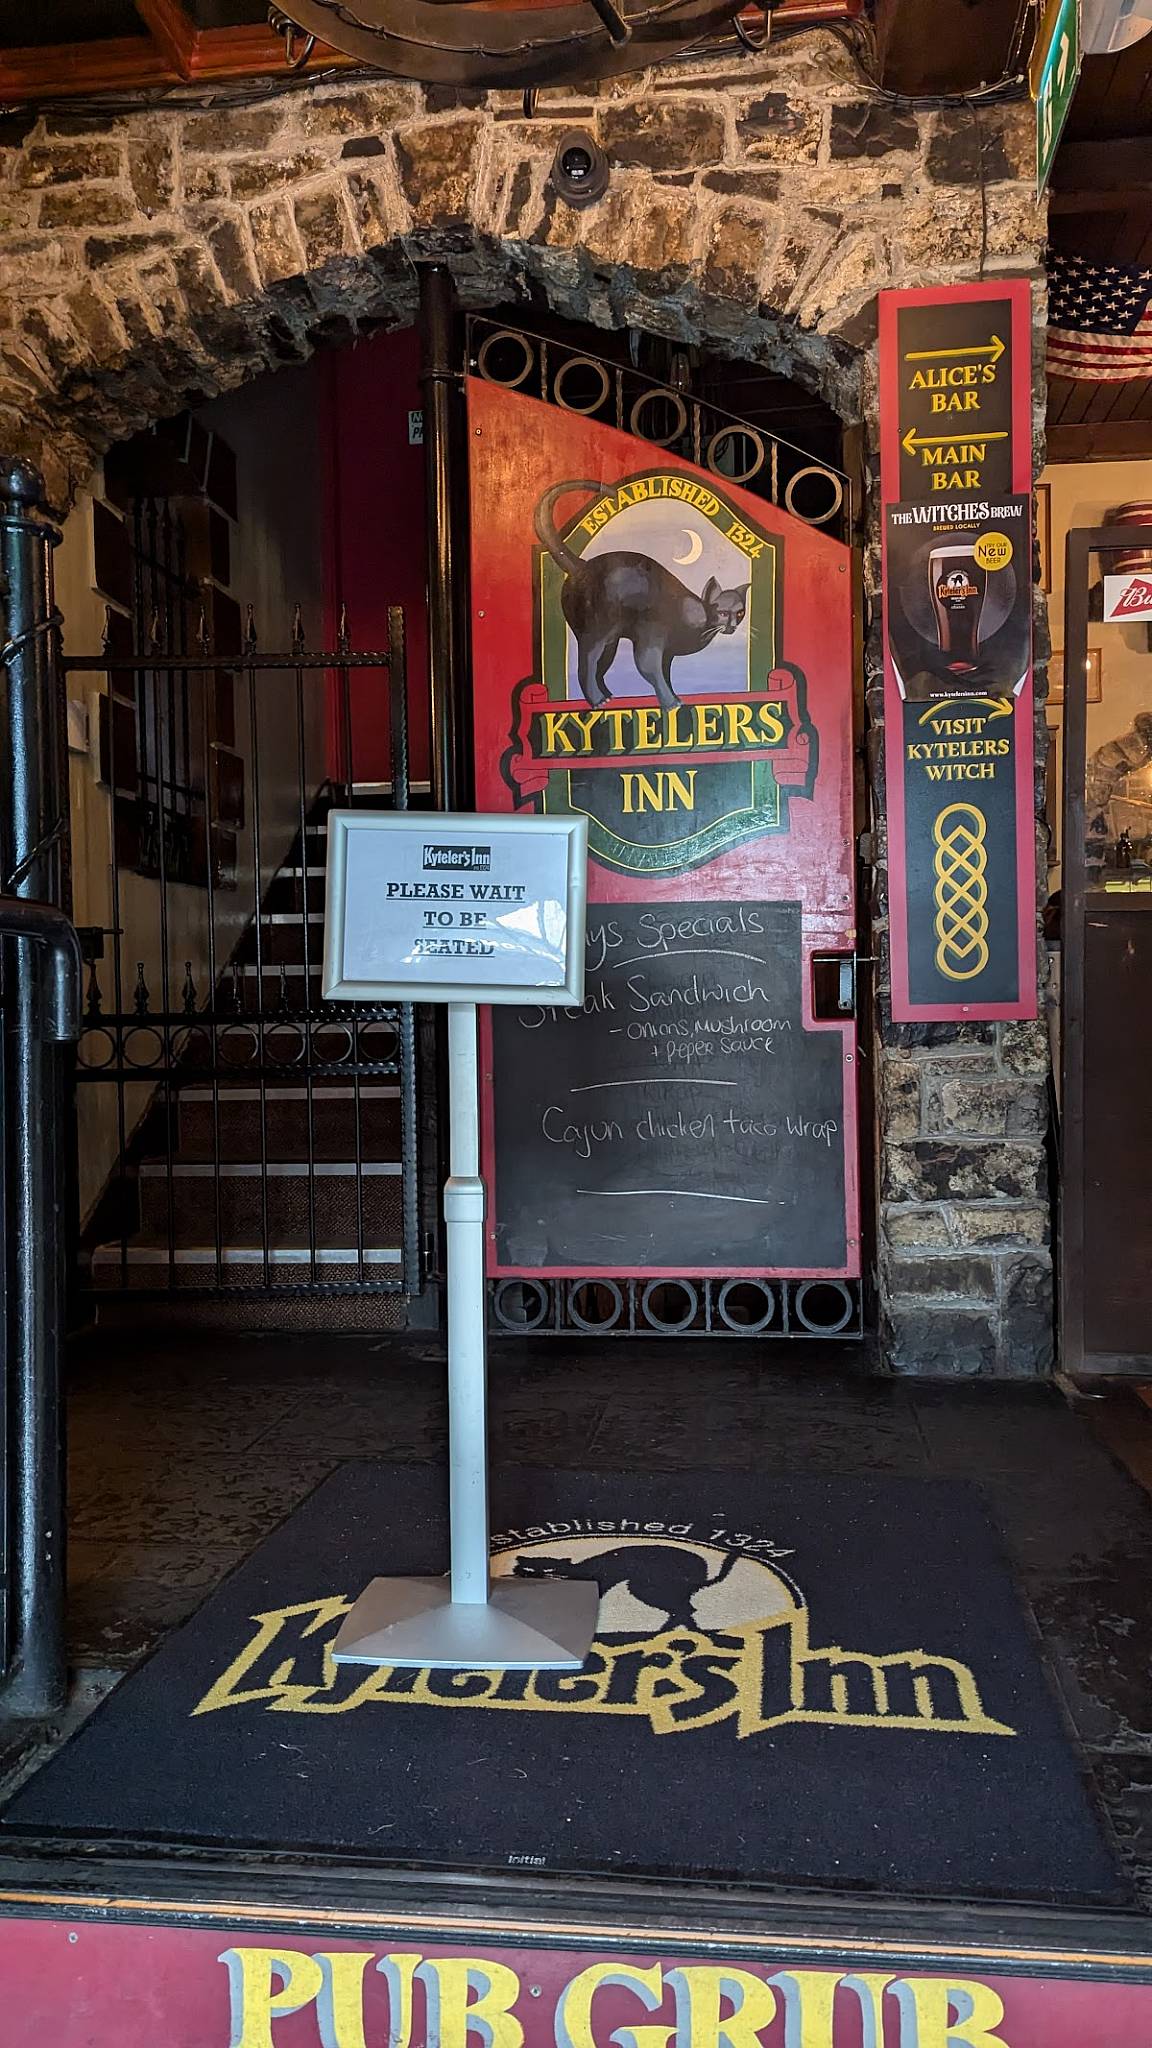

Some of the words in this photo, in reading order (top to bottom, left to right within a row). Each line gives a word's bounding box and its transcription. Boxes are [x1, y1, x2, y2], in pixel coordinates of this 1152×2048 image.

[908, 364, 996, 390] ALICE'S
[931, 391, 980, 413] BAR
[921, 443, 986, 466] MAIN
[932, 470, 981, 491] BAR
[580, 475, 720, 537] ESTABLISHED
[724, 521, 761, 559] 1324
[891, 512, 913, 525] THE
[911, 501, 990, 524] WITCHES
[990, 505, 1023, 519] BREW
[955, 522, 981, 530] LOCALLY
[978, 545, 1007, 558] New
[540, 702, 785, 757] KYTELERS
[930, 717, 987, 736] VISIT
[906, 739, 1010, 760] KYTELERS
[924, 763, 995, 781] WITCH
[620, 770, 698, 814] INN
[424, 846, 471, 867] Kyteler's
[471, 848, 490, 866] Inn
[386, 882, 464, 900] PLEASE
[470, 885, 526, 902] WAIT
[423, 911, 454, 928] TO
[459, 912, 487, 928] BE
[636, 906, 765, 951] Specials
[414, 938, 495, 957] SEATED
[626, 974, 770, 1012] Sandwich
[542, 1106, 624, 1158] Cajun
[490, 1518, 695, 1547] stablished
[710, 1528, 797, 1558] 1324
[738, 1607, 1016, 1740] Inn
[218, 1947, 526, 2048] PUB
[553, 1961, 1006, 2048] GRUB
